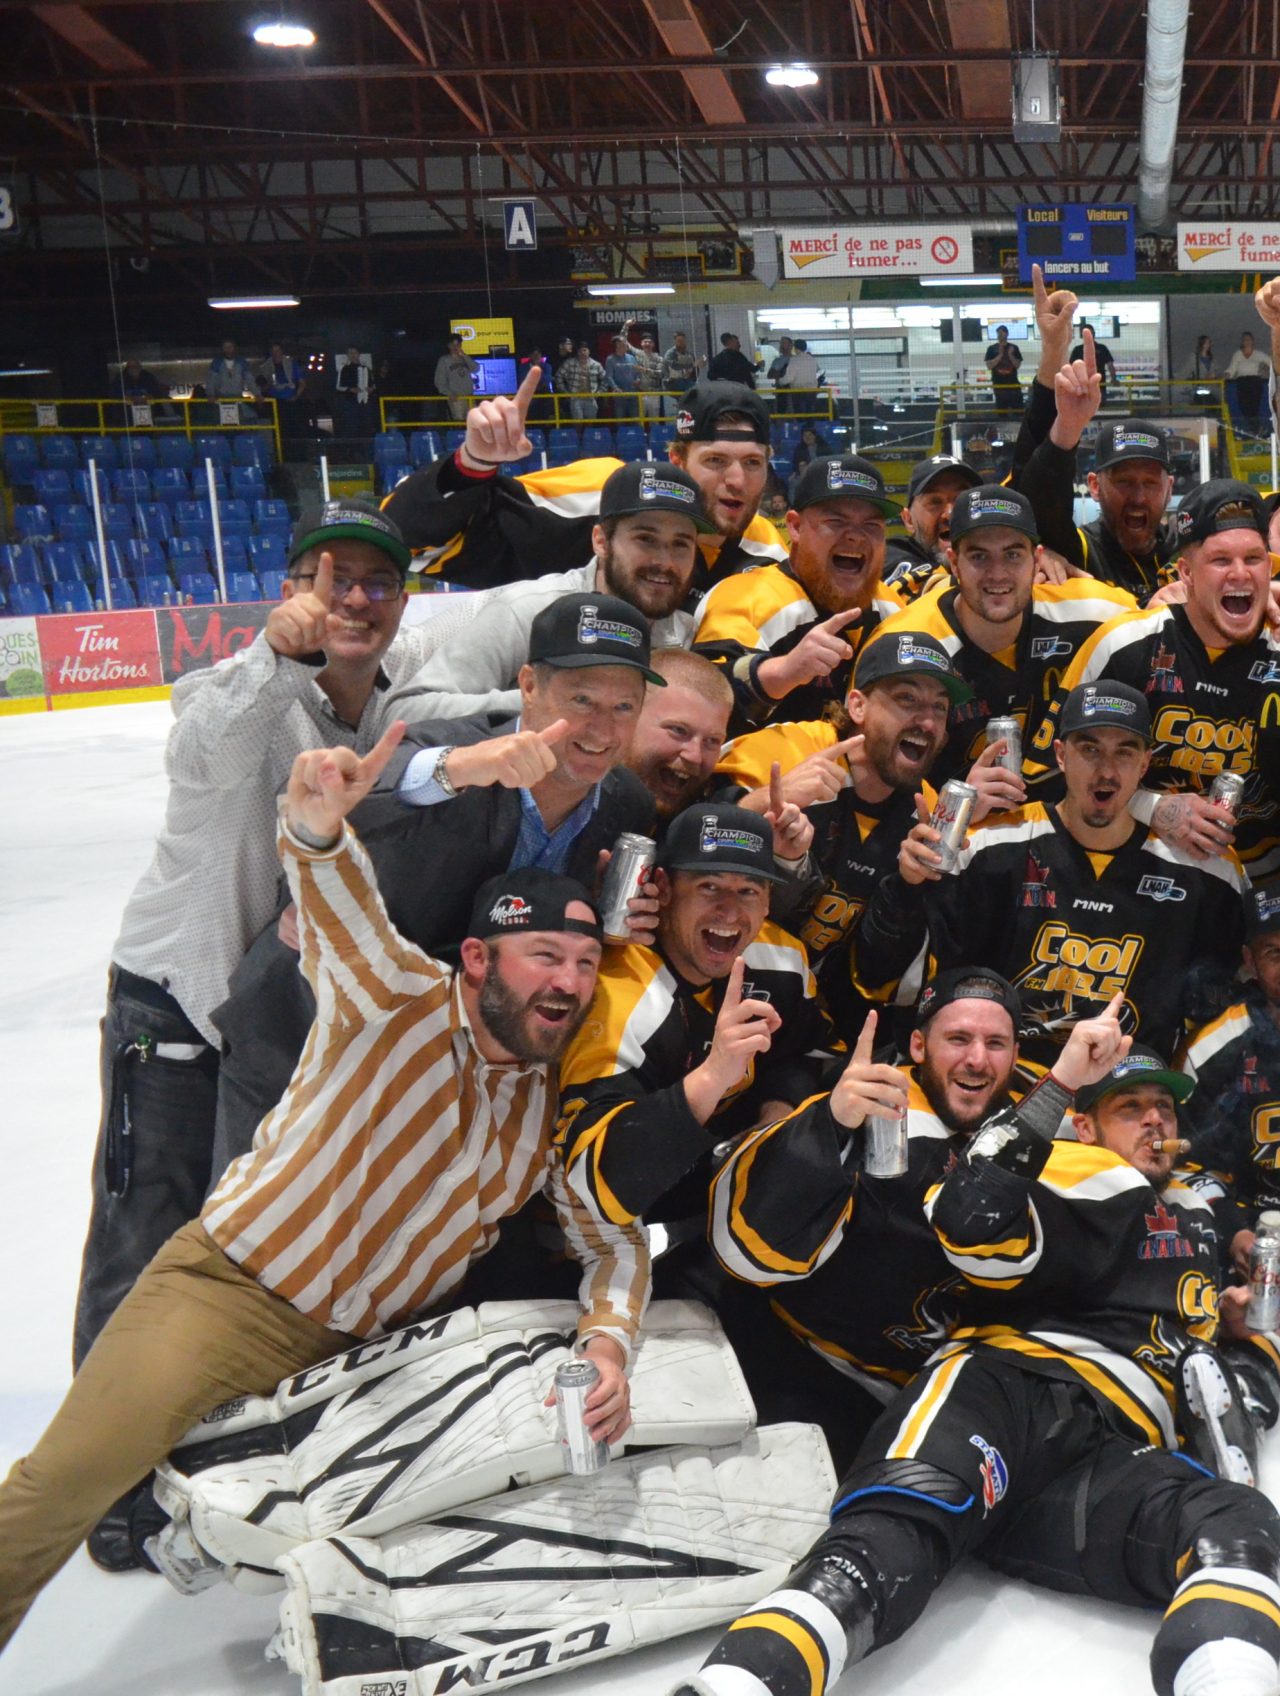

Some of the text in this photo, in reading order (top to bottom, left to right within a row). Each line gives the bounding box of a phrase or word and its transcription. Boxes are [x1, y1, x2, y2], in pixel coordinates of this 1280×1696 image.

[508, 206, 534, 245] A
[1027, 209, 1129, 222] Local Visiteurs
[844, 237, 862, 252] de
[870, 239, 889, 251] ne
[895, 238, 922, 253] pas
[1237, 232, 1255, 246] de
[1262, 235, 1280, 246] ne
[1044, 260, 1110, 275] lancers au but
[596, 311, 652, 323] HOMMES
[75, 625, 119, 653] Tim
[59, 656, 148, 685] Hortons
[489, 903, 532, 925] Molson
[1073, 898, 1114, 913] MNM
[1036, 926, 1140, 976] Cool
[1043, 964, 1126, 1002] 103.5
[287, 1313, 454, 1398] CCM
[970, 1435, 1003, 1502] STEMATI
[434, 1621, 612, 1695] CCM
